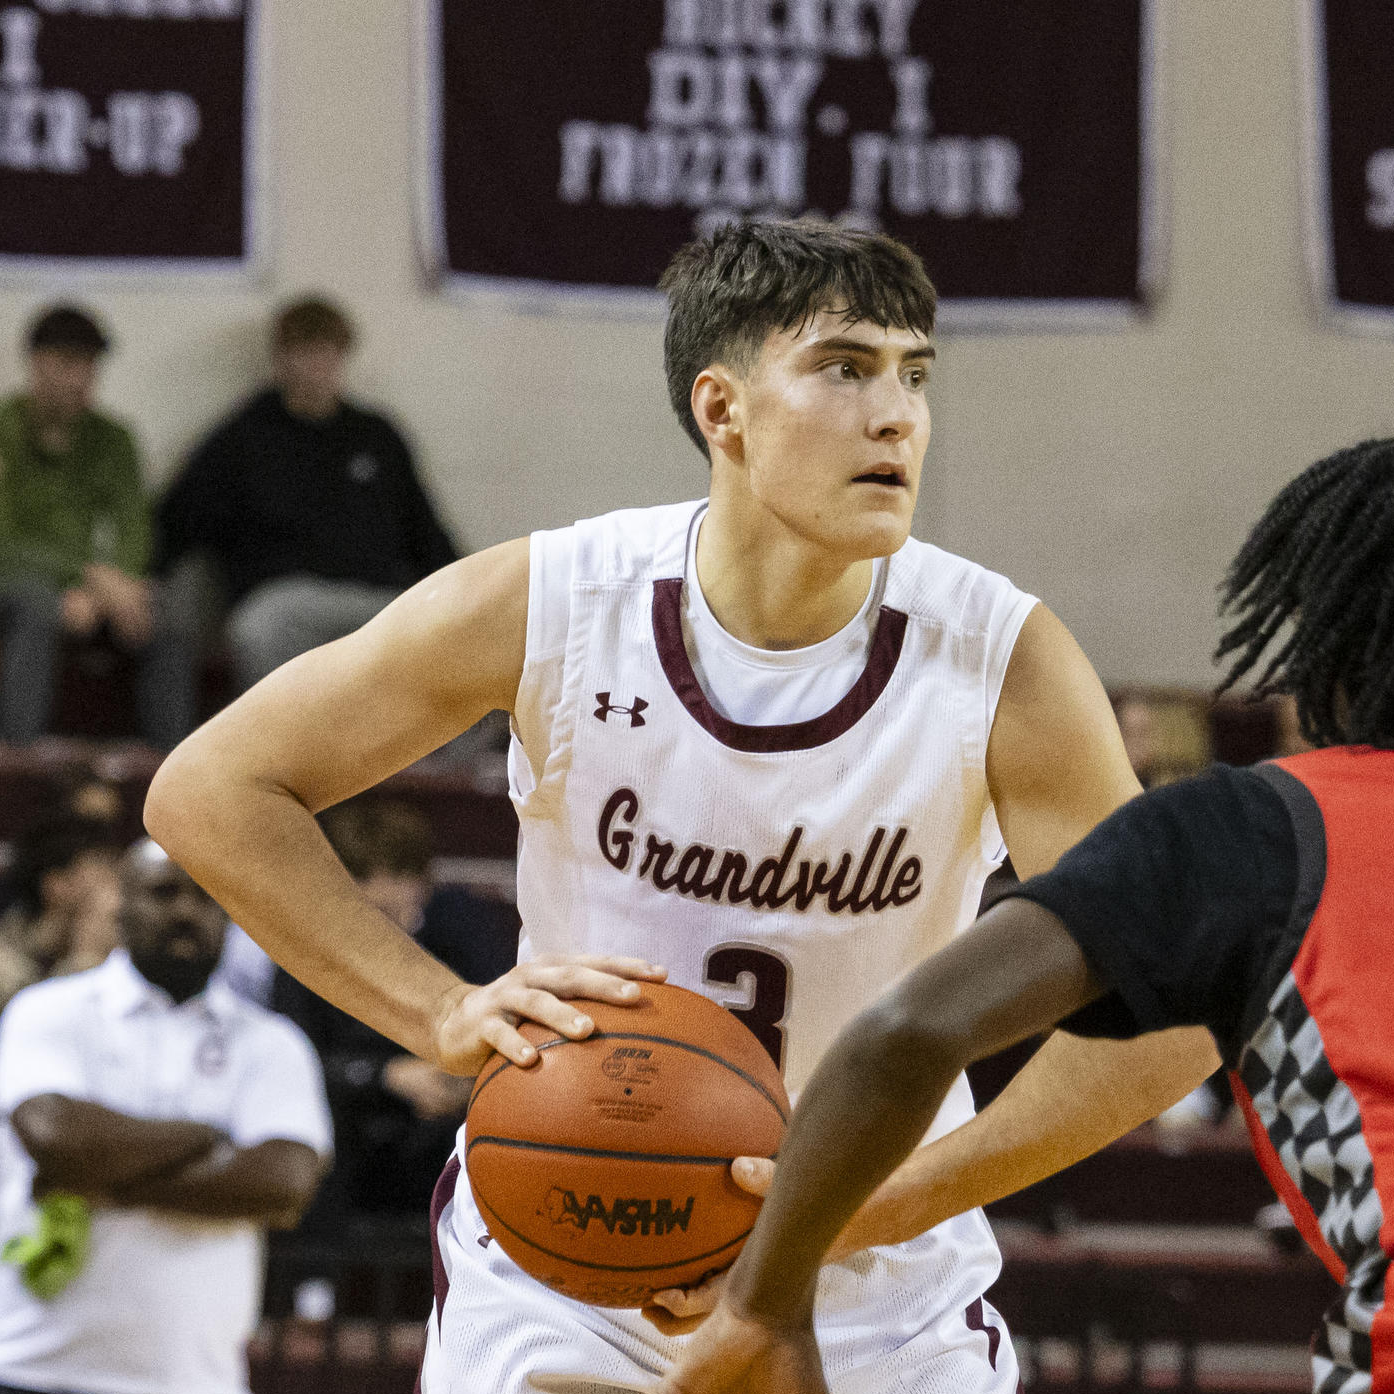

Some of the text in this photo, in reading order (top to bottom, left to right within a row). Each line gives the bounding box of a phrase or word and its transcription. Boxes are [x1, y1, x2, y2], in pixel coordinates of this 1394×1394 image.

[558, 118, 1025, 219] FROZEN FOUR
[597, 788, 924, 916] Grandville
[703, 941, 791, 1074] 3
